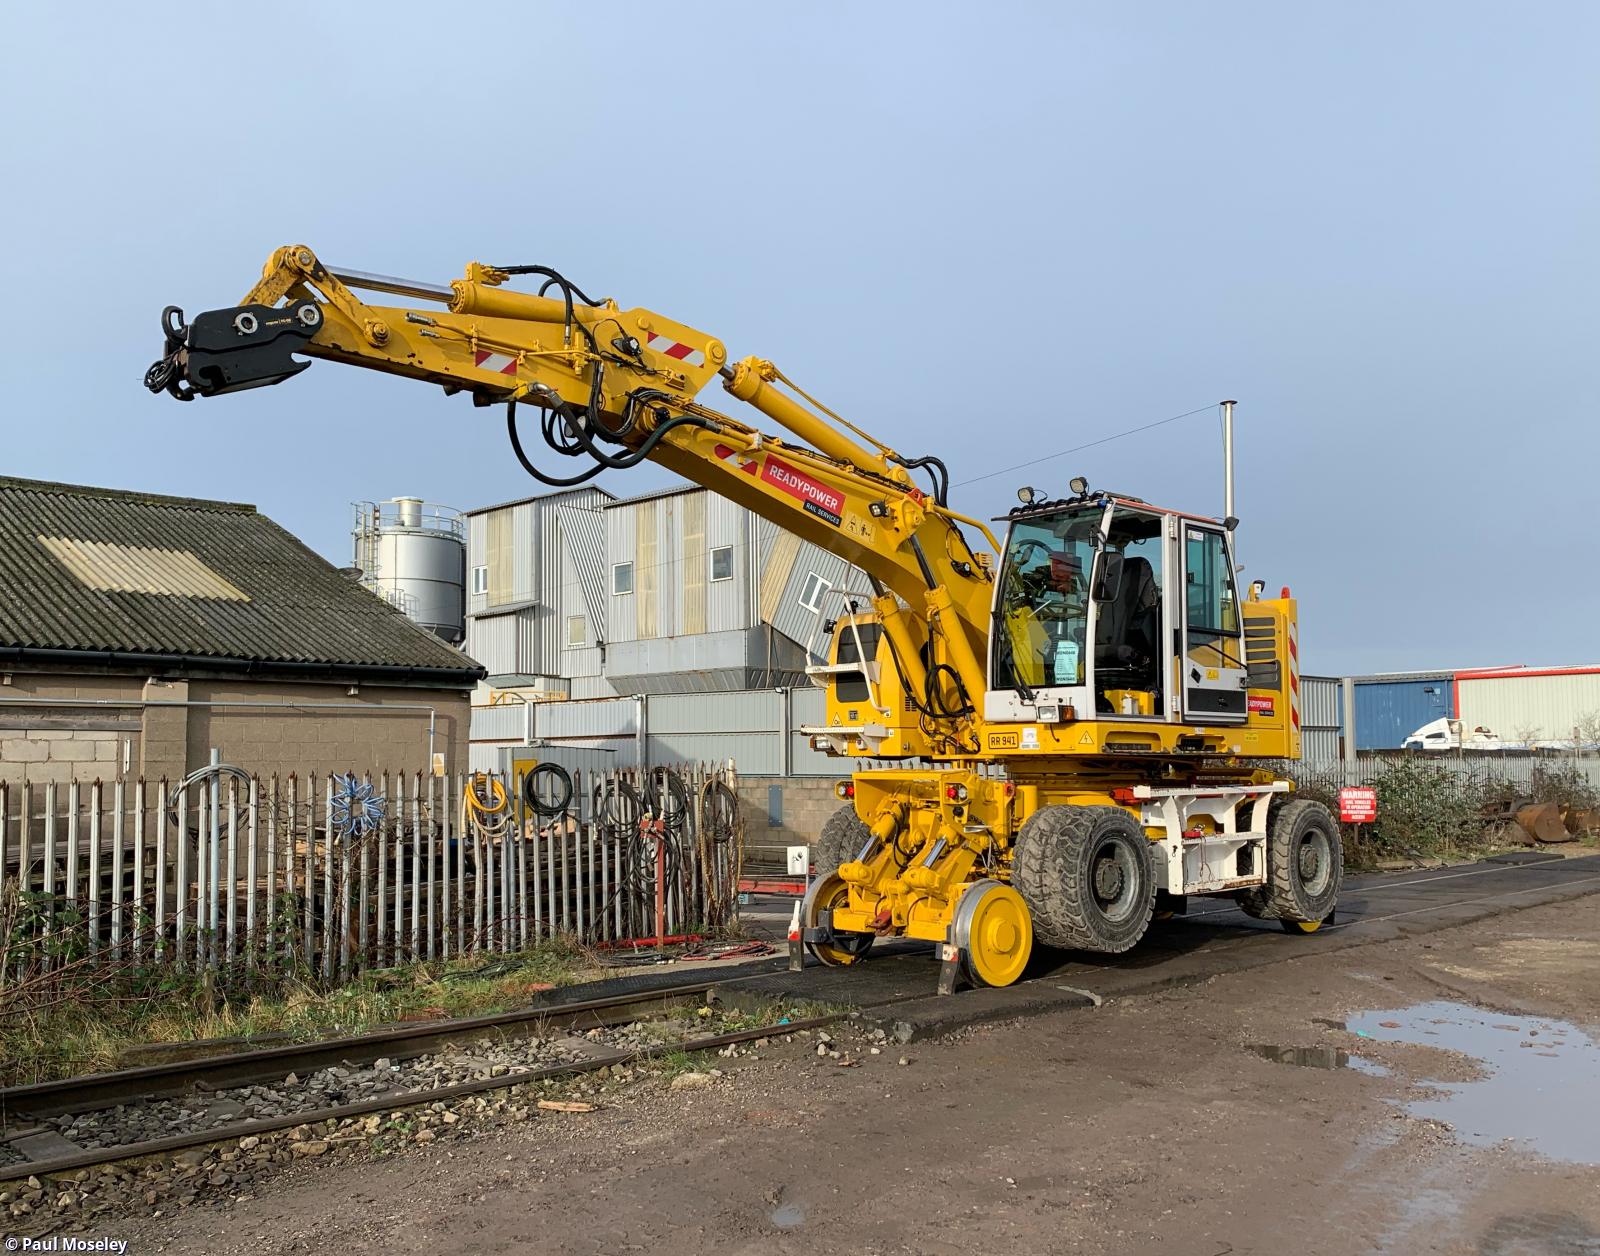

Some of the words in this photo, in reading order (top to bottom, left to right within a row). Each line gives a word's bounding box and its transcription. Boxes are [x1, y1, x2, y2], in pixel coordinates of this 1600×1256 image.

[769, 464, 838, 510] READYPOWER
[806, 502, 818, 514] RAIL
[817, 508, 841, 525] SERVICES
[990, 737, 1001, 745] RR
[1341, 790, 1374, 799] WARNING
